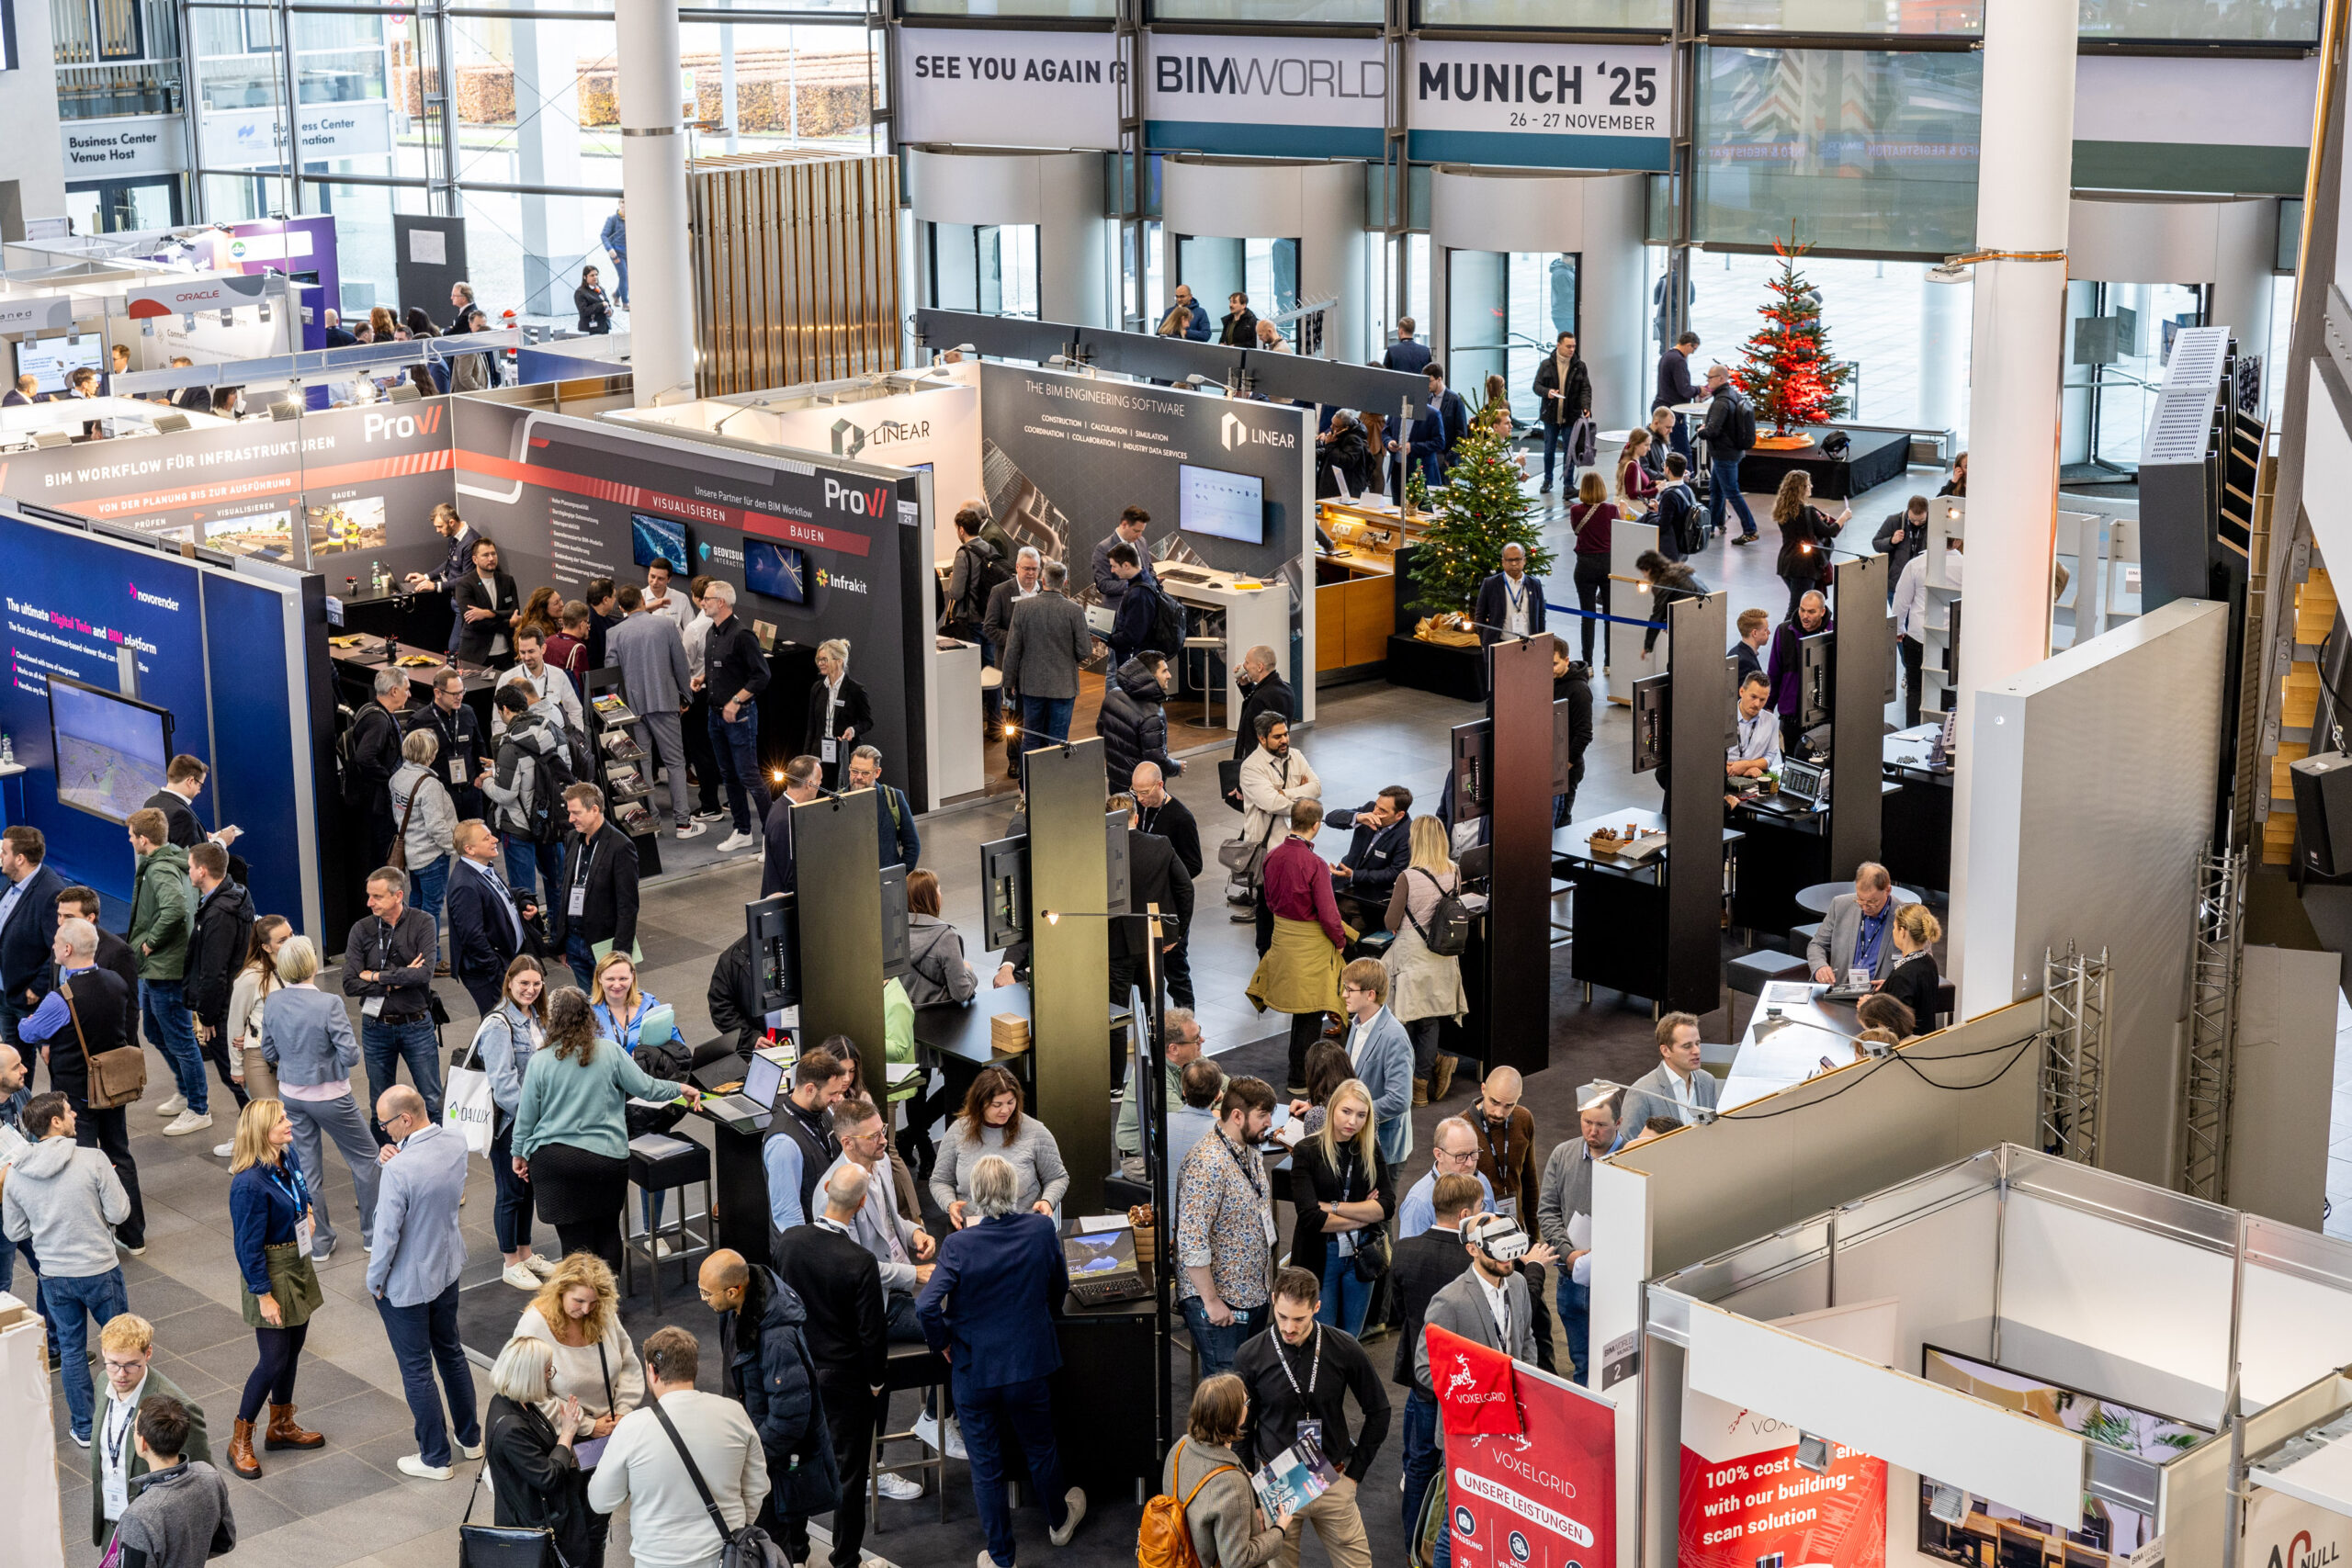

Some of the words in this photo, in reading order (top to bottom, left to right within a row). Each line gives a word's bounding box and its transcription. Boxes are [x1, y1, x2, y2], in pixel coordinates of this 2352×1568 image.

[915, 55, 961, 80] SEE
[968, 56, 1015, 81] YOU
[1023, 59, 1102, 84] AGAIN
[1156, 56, 1386, 98] BIMWORLD
[1419, 62, 1583, 105] MUNICH
[273, 122, 318, 133] Buess
[321, 118, 355, 130] Center
[1510, 112, 1528, 127] 26
[1543, 113, 1560, 128] 27
[1566, 114, 1656, 131] NOVEMBER
[69, 135, 118, 149] Business
[120, 132, 157, 145] Center
[71, 151, 107, 164] Venue
[109, 149, 135, 161] Host
[176, 290, 220, 301] ORACLE
[167, 329, 187, 340] Connect
[1025, 380, 1044, 394] THE
[1046, 384, 1063, 397] BIM
[1065, 387, 1129, 409] ENGINEERING
[1131, 398, 1185, 417] SOFTWARE
[874, 420, 930, 446] LINEAR
[1041, 414, 1082, 427] CONSTRUCTION
[1091, 423, 1127, 435] CALCULATION
[1135, 429, 1169, 442] SIMULATION
[1251, 428, 1295, 449] LINEAR
[1023, 425, 1064, 439] COORDINATION
[1072, 433, 1116, 447] COLLABORATION
[1123, 442, 1148, 454] INDUSTRY
[1148, 446, 1162, 457] DATA
[1162, 448, 1188, 460] SERVICES
[45, 471, 73, 487] BIM
[77, 459, 162, 482] WORKFLOW
[166, 453, 195, 471] FÜR
[199, 436, 335, 467] INFRASTRUKTUREN
[98, 502, 118, 513] VON
[121, 500, 140, 511] DER
[143, 491, 187, 506] PLANUNG
[190, 489, 206, 500] BIS
[209, 484, 226, 497] ZUR
[230, 478, 291, 495] AUSFÜHRUNG
[332, 490, 356, 500] BAUEN
[695, 485, 718, 501] Unsere
[718, 490, 742, 504] Partner
[743, 495, 752, 506] für
[754, 497, 766, 510] den
[768, 500, 781, 512] BIM
[782, 502, 813, 520] Workflow
[217, 502, 275, 517] VISUALISIEREN
[652, 496, 726, 522] VISUALISIEREN
[904, 514, 911, 524] 29
[134, 518, 166, 529] PRÜFEN
[790, 525, 824, 542] BAUEN
[713, 546, 744, 561] GEOVISUA
[714, 558, 744, 570] INTERACTIV
[831, 574, 867, 594] Infrakit
[138, 590, 179, 612] novorender
[6, 597, 19, 613] The
[21, 602, 50, 622] ultimate
[51, 611, 74, 629] Digital
[74, 617, 92, 635] Twin
[93, 626, 107, 639] and
[107, 628, 123, 644] BIM
[124, 634, 157, 655] platform
[8, 621, 17, 631] The
[26, 626, 38, 638] cloud
[98, 649, 107, 660] that
[461, 1108, 491, 1125] DALUX
[1604, 1337, 1634, 1358] BIMWORLD
[1617, 1346, 1634, 1356] MUNICH
[1308, 1362, 1318, 1393] AUTODESK
[1614, 1363, 1622, 1381] 2
[1456, 1393, 1507, 1404] VOXELGRID
[1492, 1447, 1577, 1499] VOXELGRID
[1705, 1465, 1750, 1489] 100%
[1754, 1456, 1790, 1478] cost
[1704, 1495, 1740, 1517] with
[1745, 1490, 1773, 1507] our
[1779, 1473, 1855, 1500] building-
[1464, 1474, 1510, 1505] UNSERE
[1512, 1495, 1583, 1540] LEISTUNGEN
[1702, 1525, 1742, 1545] scan
[1747, 1507, 1817, 1534] solution
[1451, 1529, 1484, 1551] ERFASSUNG
[2132, 1540, 2162, 1566] BIMWORLD
[2145, 1551, 2162, 1564] MUNICH
